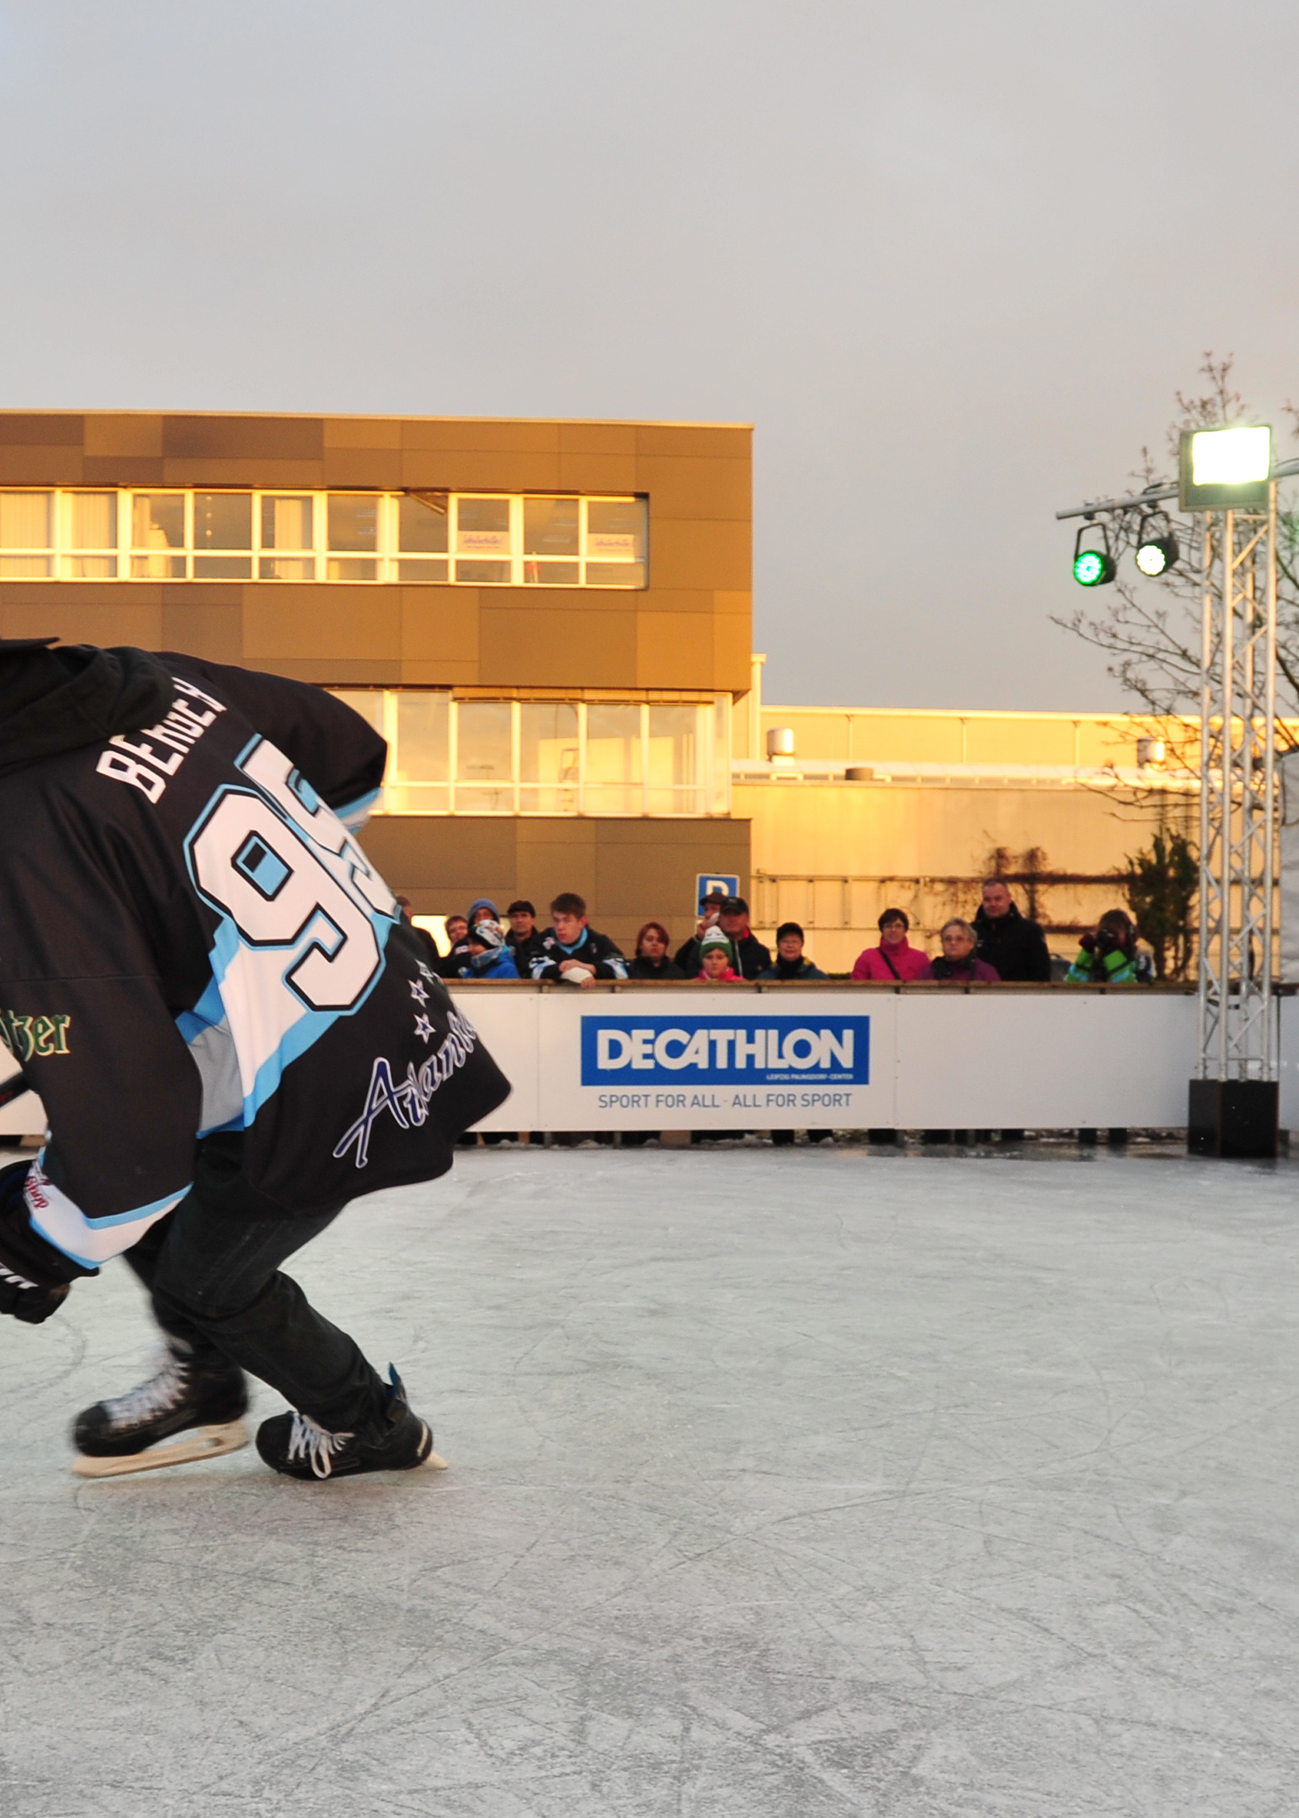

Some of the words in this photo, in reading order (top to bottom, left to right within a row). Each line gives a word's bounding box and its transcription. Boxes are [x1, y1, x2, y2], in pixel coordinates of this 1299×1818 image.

[183, 732, 401, 1016] 95
[597, 1028, 854, 1070] DECATHLON
[598, 1094, 650, 1109] SPORT
[655, 1094, 686, 1109] FOR
[690, 1093, 721, 1108] ALL
[731, 1093, 761, 1108] ALL
[766, 1093, 797, 1107] FOR
[800, 1093, 853, 1107] SPORT
